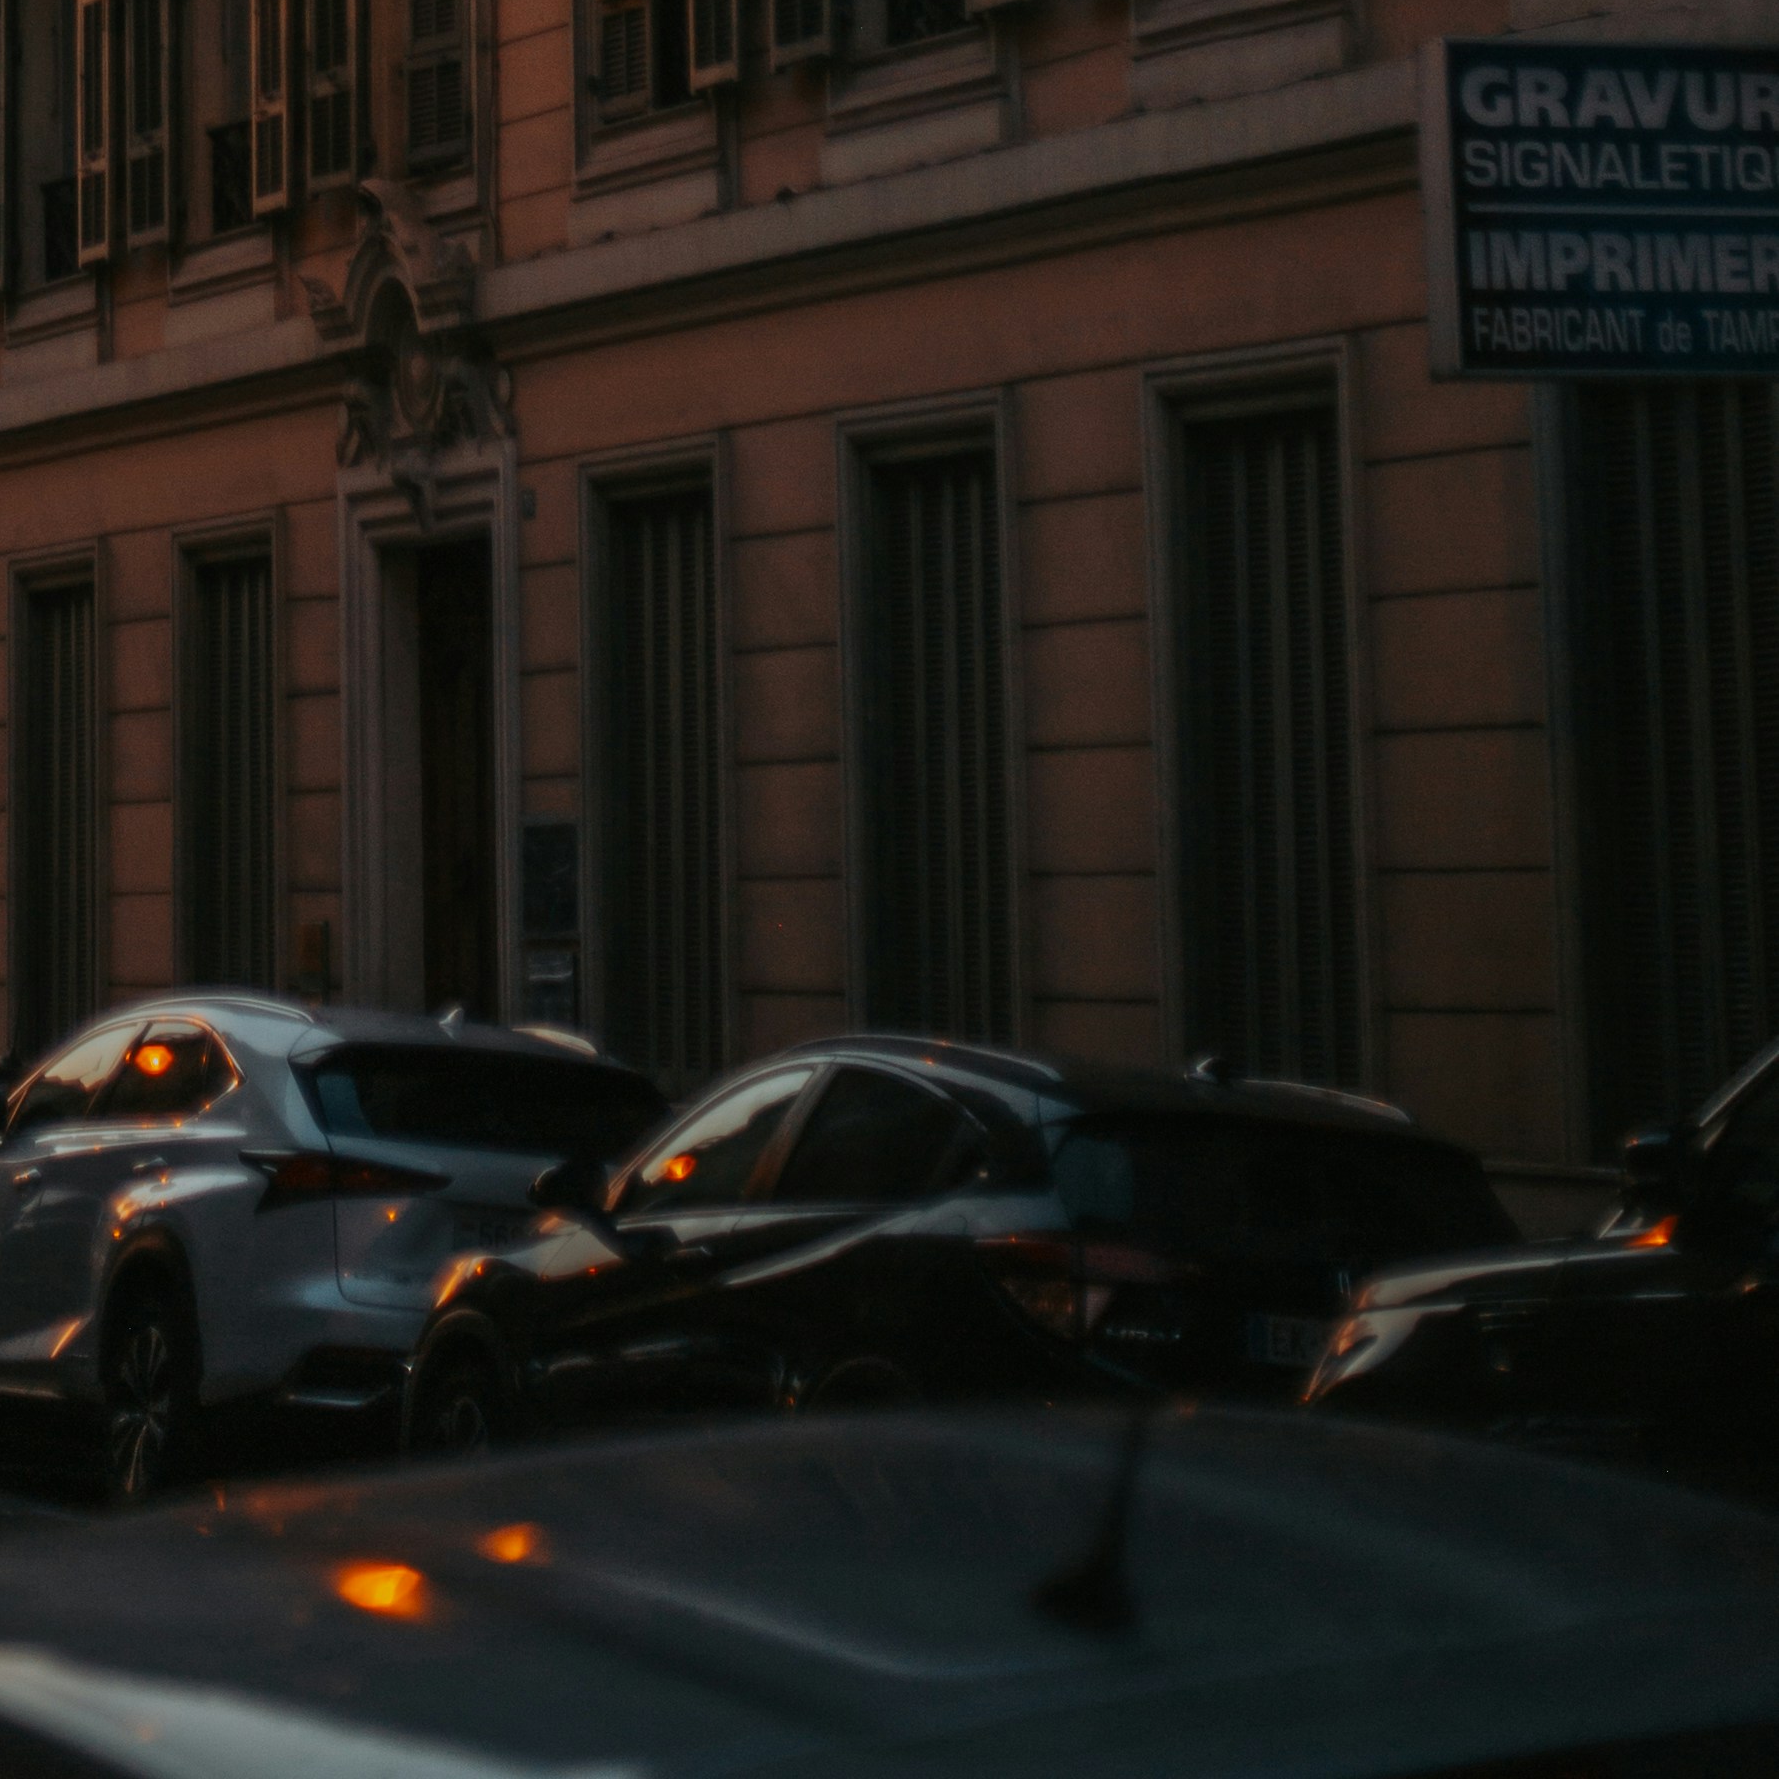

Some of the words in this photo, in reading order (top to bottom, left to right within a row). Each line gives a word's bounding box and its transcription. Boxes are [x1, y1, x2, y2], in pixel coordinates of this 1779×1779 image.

[1460, 64, 1779, 132] GRAVUR
[1463, 139, 1779, 192] SIGNALETIQ
[1467, 229, 1779, 294] IMPRIMER
[1472, 307, 1646, 353] FABRICANT
[1657, 309, 1693, 354] de
